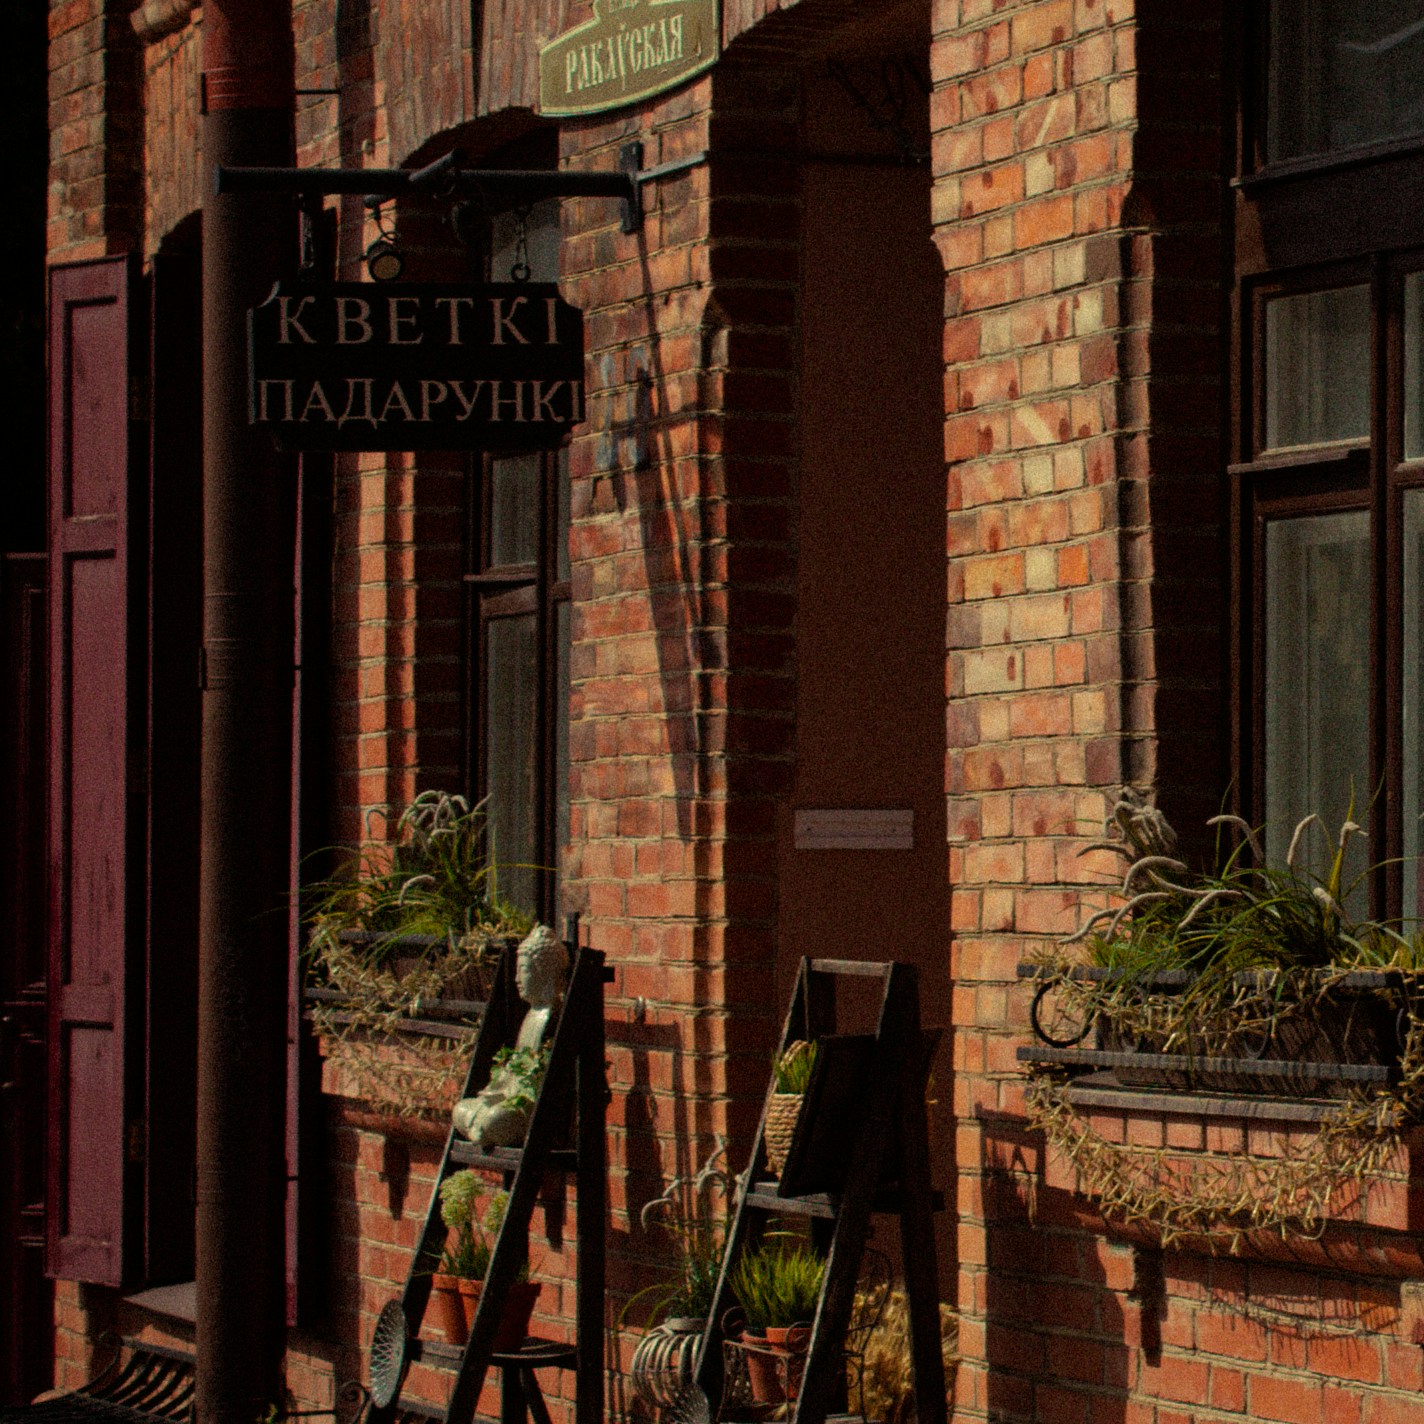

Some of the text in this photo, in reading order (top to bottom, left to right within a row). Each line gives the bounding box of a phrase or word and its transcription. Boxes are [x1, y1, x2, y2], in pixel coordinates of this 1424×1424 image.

[565, 14, 684, 94] РАКАЎСКАЯ
[276, 295, 562, 346] КВЕТКІ
[256, 378, 583, 431] ПАДАРУНКІ
